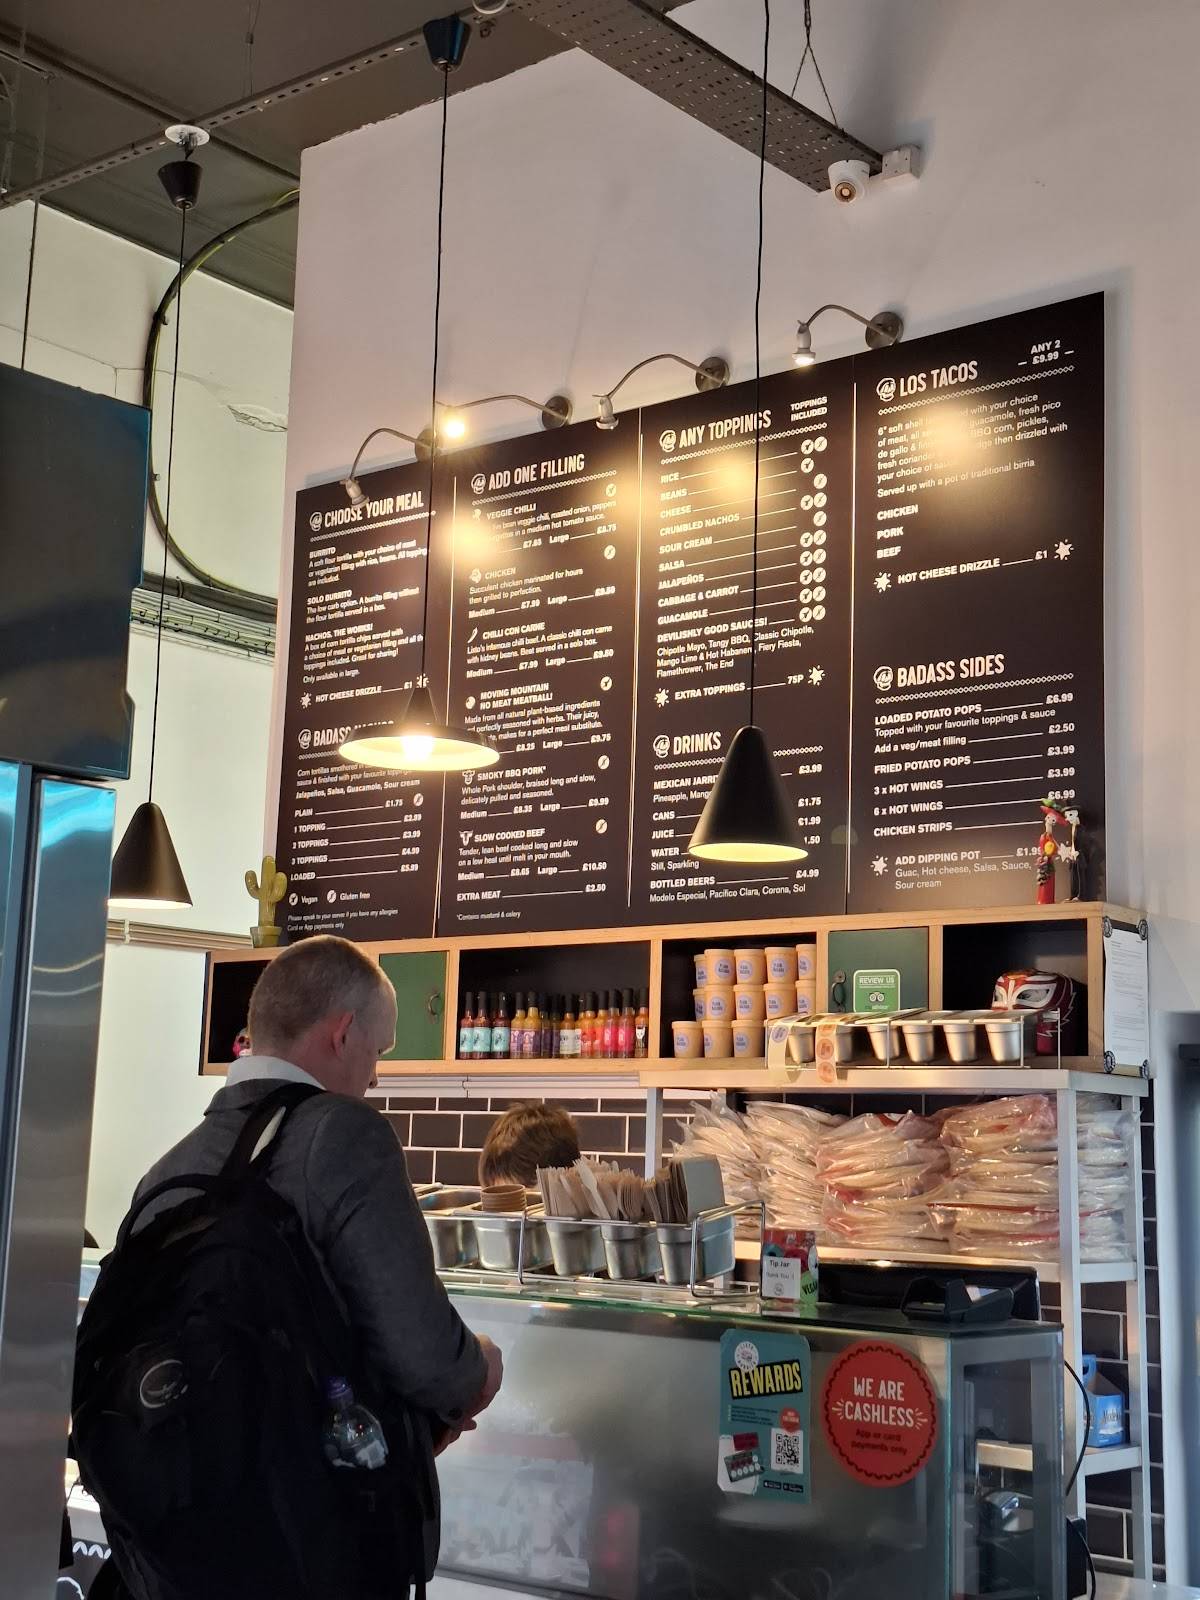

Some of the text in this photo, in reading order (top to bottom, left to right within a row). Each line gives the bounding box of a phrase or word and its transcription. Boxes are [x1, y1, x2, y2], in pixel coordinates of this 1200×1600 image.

[1030, 340, 1061, 354] ANY 2
[1032, 352, 1059, 365] £9.99
[900, 360, 978, 397] LOS TACOS
[790, 396, 828, 411] TOPPINGS
[791, 407, 828, 421] INCLUDED
[679, 409, 771, 449] ANY TOPPINGS
[489, 453, 584, 490] ADD ONE FILLING
[661, 473, 679, 484] RICE
[661, 488, 687, 501] BEANS
[324, 491, 424, 528] CHOOSE YOUR MEAL
[486, 503, 536, 520] VEGGIE CHILLI
[660, 505, 692, 518] CHEESE
[877, 504, 919, 520] CHICKEN
[660, 513, 740, 536] CRUMBLED NACHOS
[877, 526, 904, 540] PORK
[310, 547, 336, 559] BURRITO
[659, 537, 713, 554] SOUR CREAM
[877, 546, 901, 559] BEEF
[659, 560, 685, 572] SALSA
[898, 550, 1048, 584] HOT CHEESE DRIZZLE £1
[485, 568, 516, 580] CHICKEN
[658, 574, 704, 590] JALAPEÑOS
[307, 590, 352, 605] SOLO BURRITO
[658, 592, 696, 608] CABBAGE
[705, 586, 739, 599] CARROT
[658, 609, 708, 625] GUACAMOLE
[306, 631, 332, 642] NACHOS.
[334, 628, 346, 636] THE
[483, 622, 545, 640] CHILLI CON CARNE
[657, 617, 768, 643] DEVILISHLY GOOD SAUCES!
[897, 654, 1005, 688] BADASS SIDES
[316, 694, 328, 702] HOT
[329, 691, 354, 700] CHEESE
[356, 686, 382, 696] DRIZZLE
[480, 683, 549, 700] MOVING MOUNTAIN
[675, 674, 804, 700] EXTRA TOPPINGS 75P
[480, 700, 491, 710] NO
[492, 699, 512, 708] MEAT
[875, 693, 1074, 725] LOADED POTATO POPS £6.99
[875, 709, 1056, 738] Topped with your favourite toppings & sauce
[673, 731, 722, 756] DRINKS
[874, 743, 891, 754] Add
[900, 739, 941, 752] veg/meat
[943, 736, 967, 748] filling
[1049, 722, 1075, 734] £2.50
[874, 745, 1075, 774] FRIED POTATO POPS £3.99
[477, 770, 520, 781] SMOKY BBQ
[654, 776, 691, 790] MEXICAN
[798, 764, 822, 775] £3.99
[881, 787, 888, 795] x
[889, 784, 909, 794] HOT
[911, 779, 944, 792] WINGS
[1047, 767, 1075, 778] £3.99
[653, 792, 688, 803] Pineapple,
[889, 805, 909, 815] HOT
[911, 801, 943, 813] WINGS
[1048, 790, 1075, 800] £6.99
[294, 808, 313, 817] PLAIN
[653, 797, 822, 821] CANS £1.75
[299, 823, 326, 832] TOPPING
[474, 828, 545, 842] SLOW COOKED BEEF
[652, 830, 674, 839] JUICE
[874, 822, 953, 837] CHICKEN STRIPS
[298, 838, 329, 848] TOPPINGS
[297, 855, 328, 864] TOPPINGS
[652, 848, 679, 857] WATER
[895, 856, 916, 866] ADD
[917, 852, 958, 864] DIPPING
[960, 851, 980, 860] POT
[651, 860, 700, 871] Still, Sparkling
[896, 860, 1032, 879] Guac, Hot cheese, Salsa, Sauce,
[291, 872, 316, 881] LOADED
[650, 869, 819, 889] BOTTLED BEERS £4.99
[896, 879, 942, 890] Sour cream
[301, 895, 318, 905] Vegan
[340, 893, 358, 901] Gluten
[457, 890, 501, 901] EXTRA MEAT
[770, 1260, 778, 1268] Tip
[730, 1362, 801, 1397] REWARDS
[854, 1377, 904, 1401] WE ARE
[844, 1401, 914, 1428] CASHLESS
